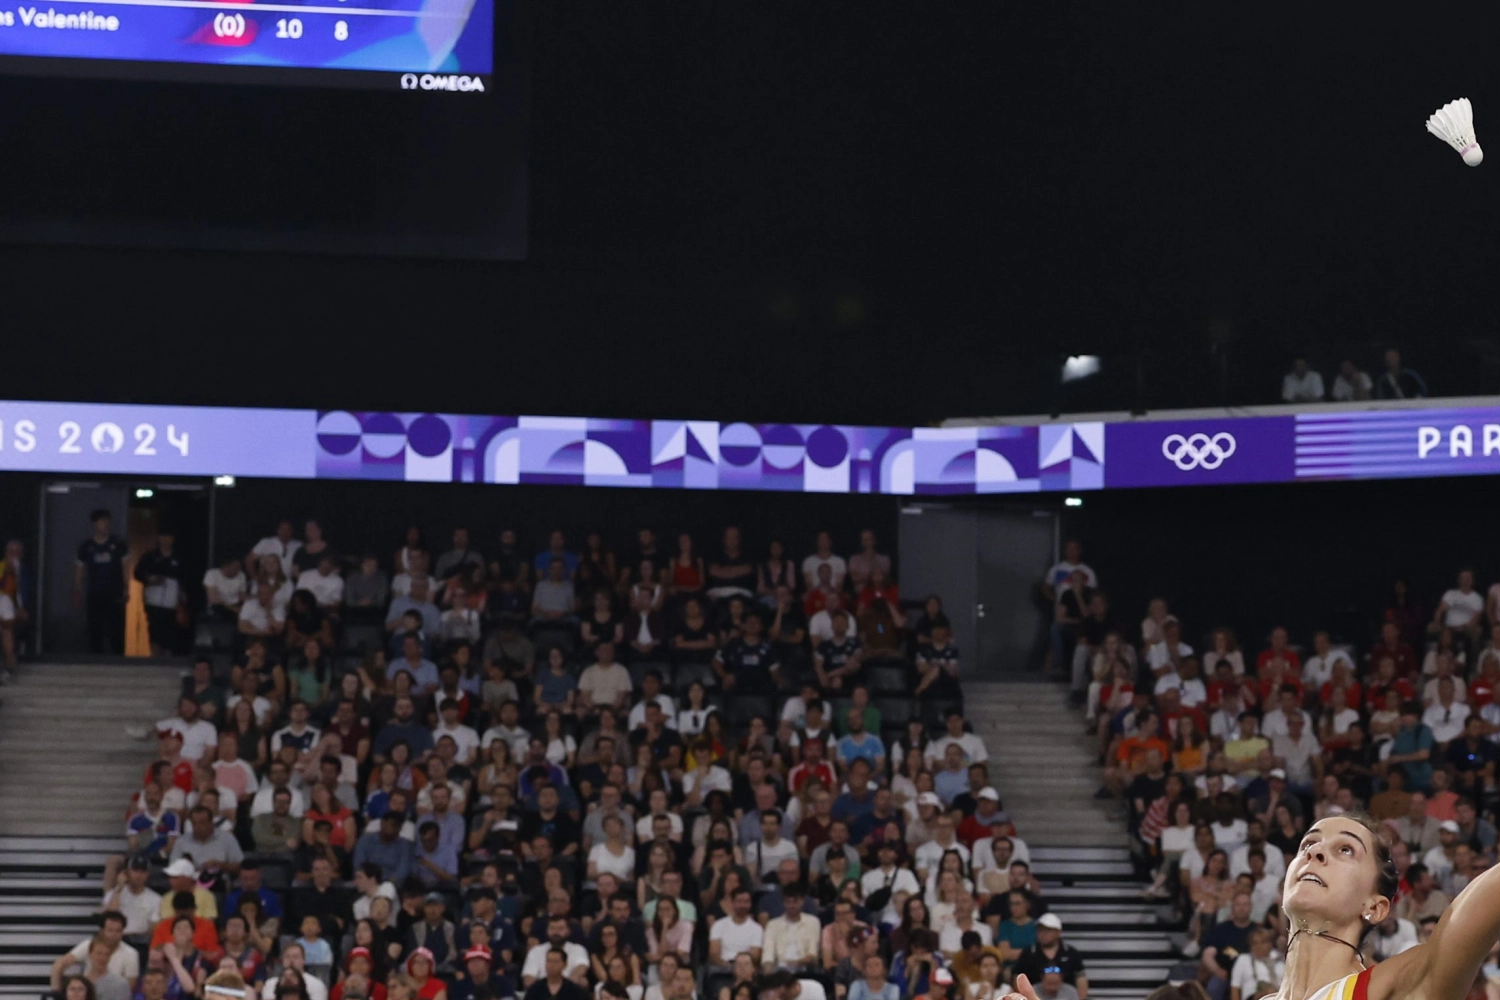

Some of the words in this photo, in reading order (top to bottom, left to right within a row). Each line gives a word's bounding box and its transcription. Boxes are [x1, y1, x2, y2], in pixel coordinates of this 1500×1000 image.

[18, 6, 120, 31] Valentine
[275, 18, 303, 39] 10
[334, 20, 349, 41] 8
[419, 73, 485, 92] OMEGA
[58, 420, 190, 457] 2024
